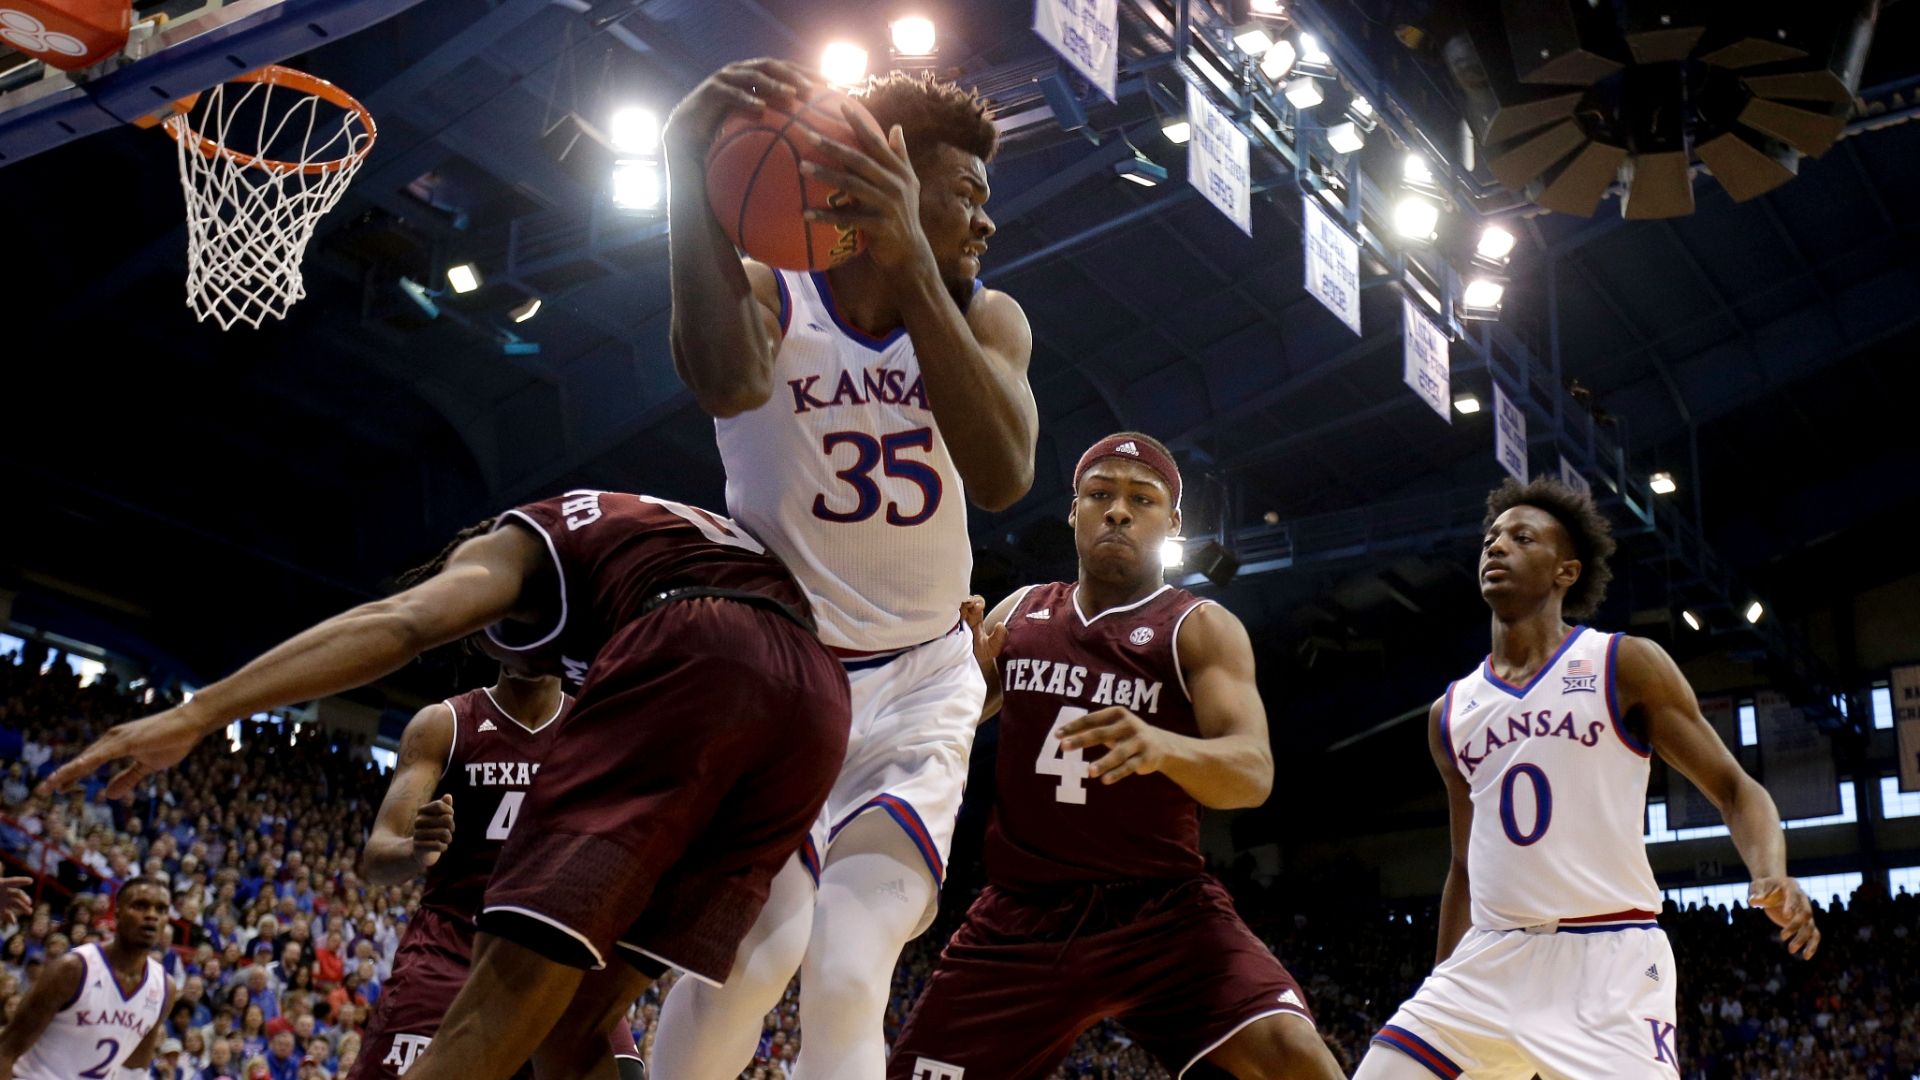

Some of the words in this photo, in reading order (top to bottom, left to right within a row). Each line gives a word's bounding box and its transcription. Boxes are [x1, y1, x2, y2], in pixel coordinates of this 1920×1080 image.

[787, 367, 932, 414] KANSA
[812, 427, 943, 527] 35
[562, 490, 602, 531] CH
[1006, 658, 1088, 698] TEXAS
[1091, 672, 1163, 714] A&M
[1035, 705, 1089, 805] 4
[1458, 709, 1605, 776] KANSAS
[465, 761, 541, 787] TEXA
[1499, 762, 1553, 847] 0
[78, 1036, 120, 1079] 2
[1644, 1018, 1680, 1076] K
